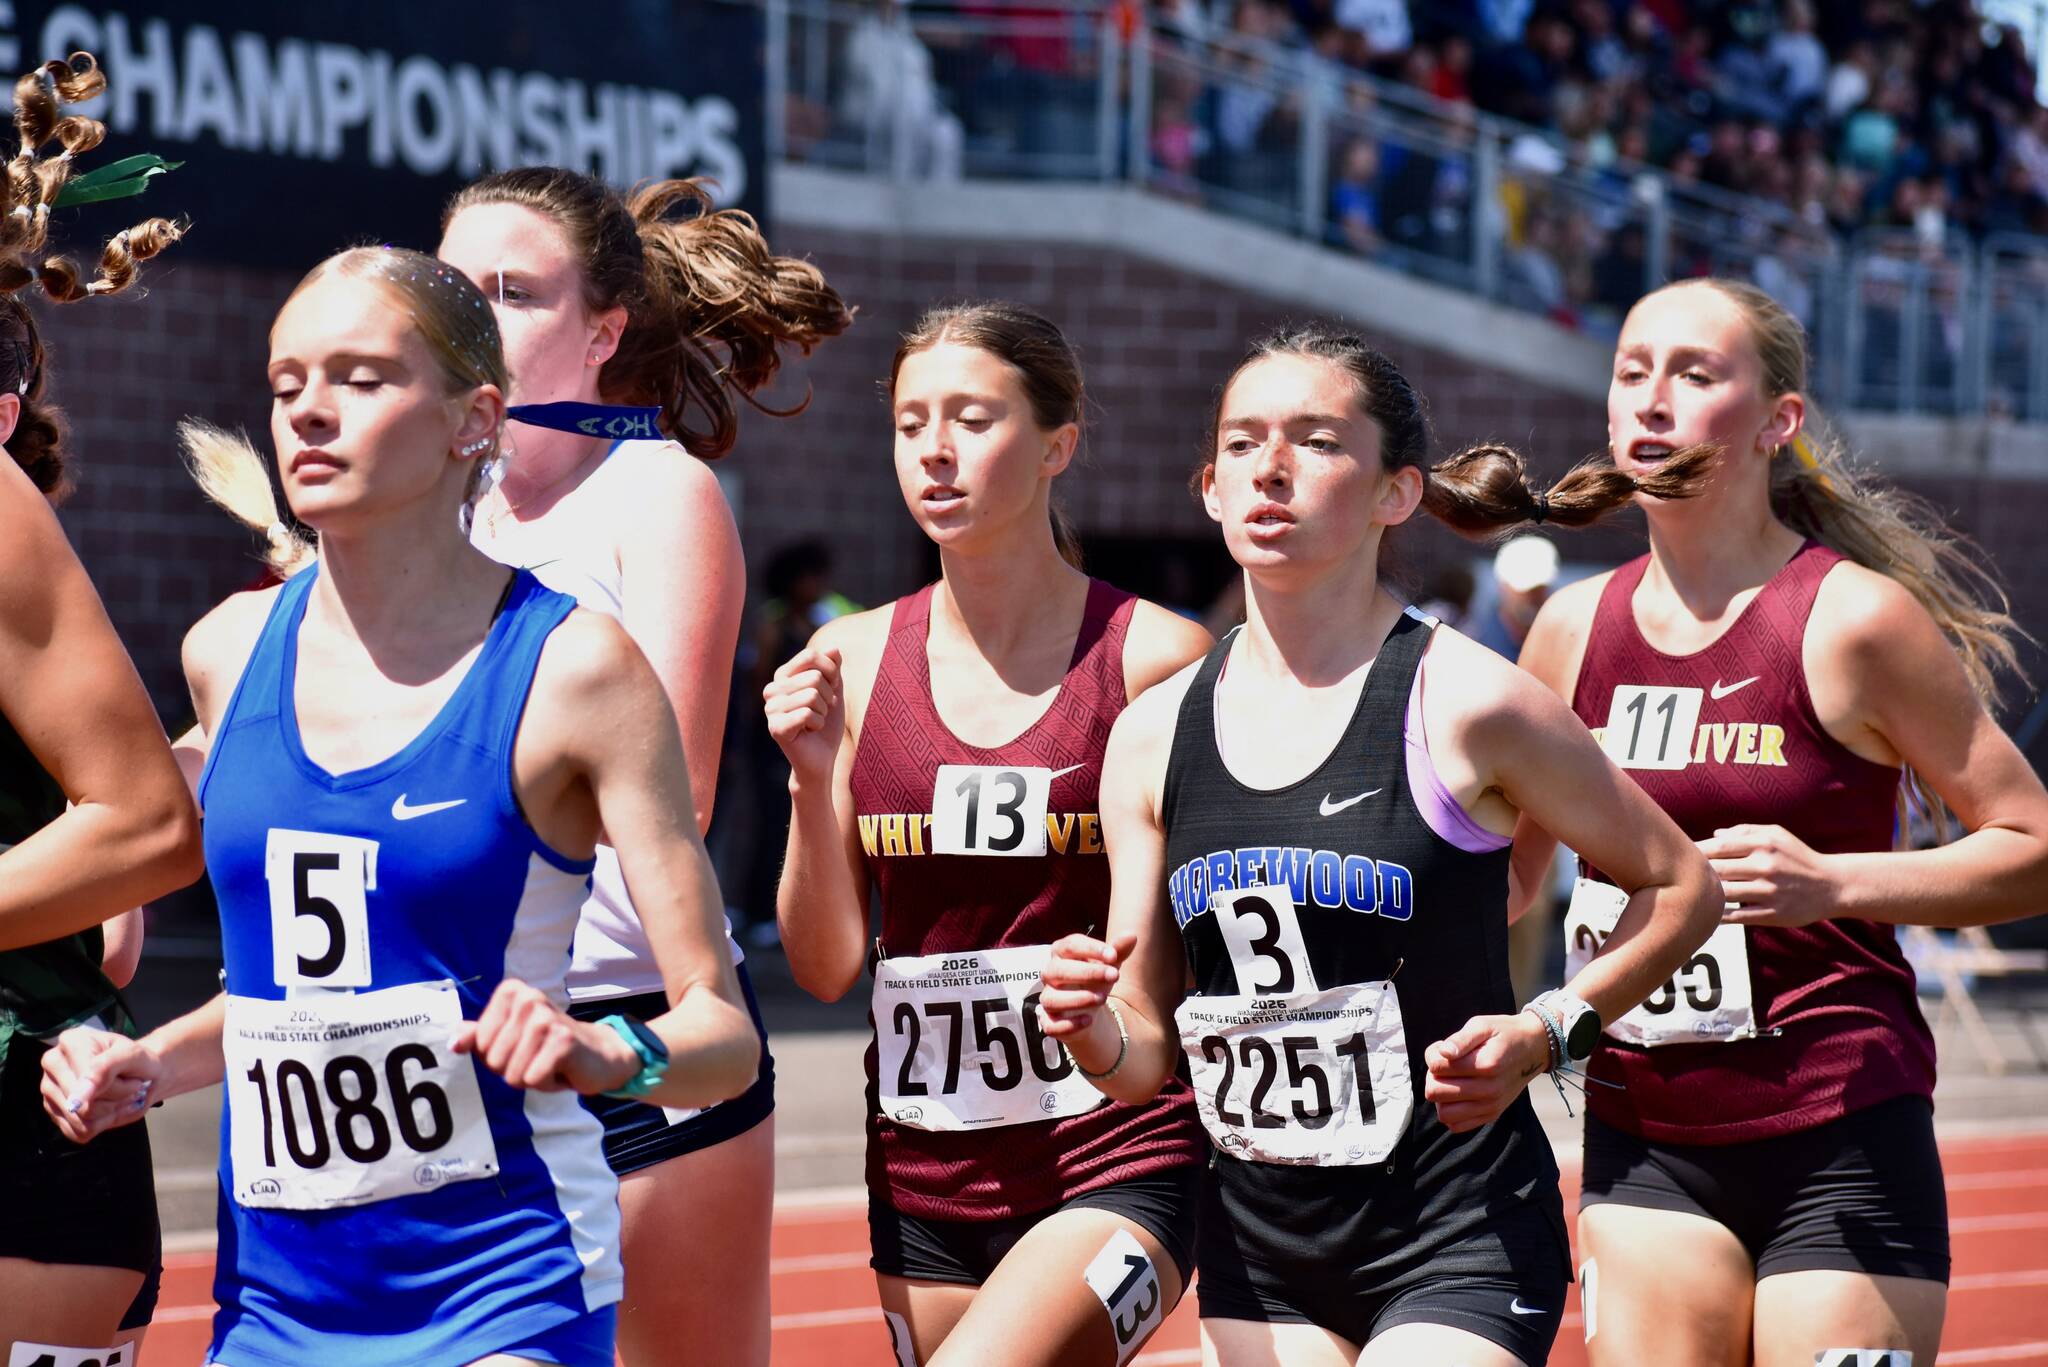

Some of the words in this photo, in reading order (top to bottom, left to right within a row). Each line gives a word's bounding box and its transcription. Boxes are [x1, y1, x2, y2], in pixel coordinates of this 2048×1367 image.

[38, 4, 748, 209] CHAMPIONSHIPS
[1626, 693, 1678, 762] 11
[1688, 723, 1788, 766] IVER
[955, 771, 1028, 852] 13
[293, 853, 346, 979] 5
[1232, 895, 1295, 996] 3
[885, 980, 907, 989] TRACK
[916, 979, 939, 988] FIELD
[942, 977, 972, 987] STATE
[974, 971, 1041, 985] CHAMPIONS
[942, 957, 979, 971] 2026
[958, 969, 978, 977] CREDIT
[979, 968, 998, 976] UNION
[265, 1031, 286, 1041] FIELD
[290, 1031, 320, 1041] STATE
[323, 1013, 431, 1041] CHAMPIONSHIPS
[1189, 1012, 1214, 1022] TRACK
[1224, 1015, 1250, 1024] FIELD
[1252, 1014, 1284, 1023] STATE
[1287, 1007, 1372, 1022] CHAMPIONSHIPS
[1251, 1000, 1287, 1010] 2026
[894, 991, 1074, 1097] 2756
[1201, 1032, 1377, 1129] 2251
[247, 1043, 454, 1169] 1086
[1106, 1253, 1158, 1345] 13
